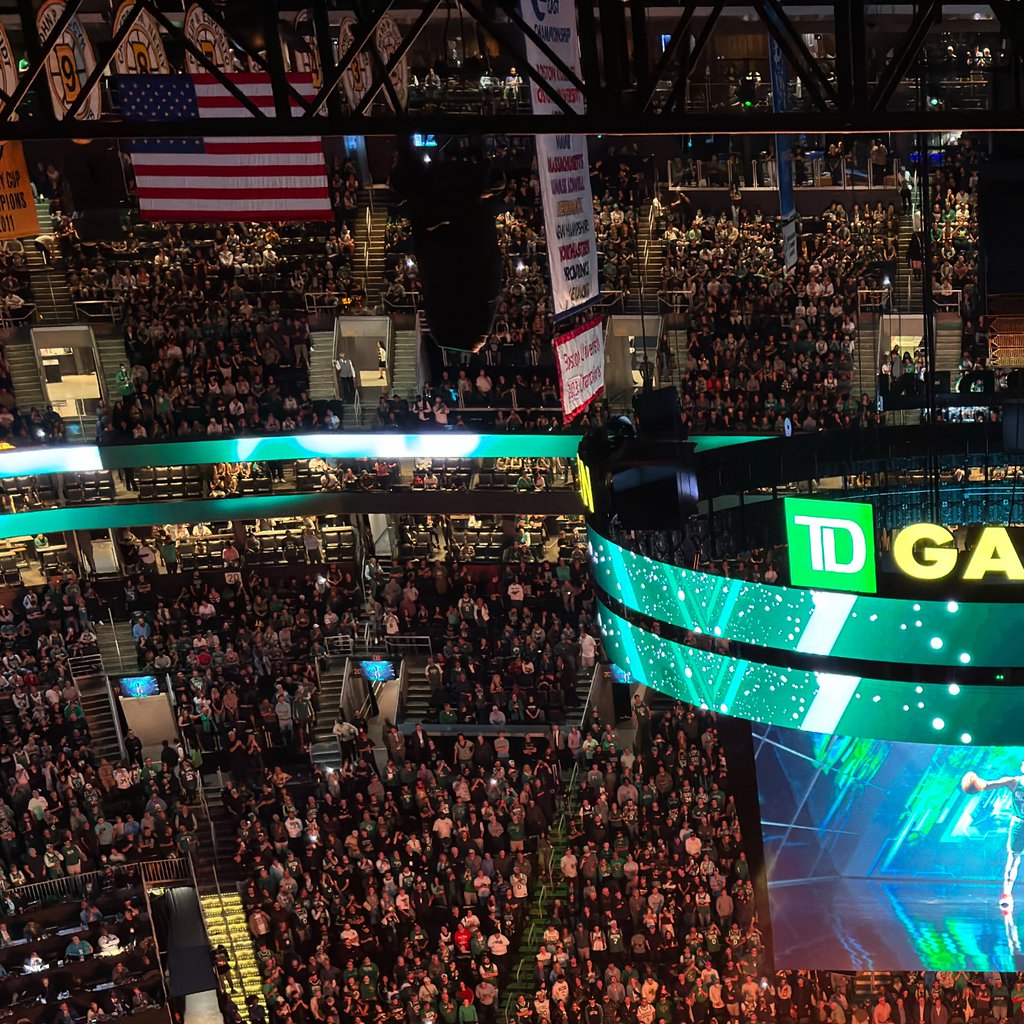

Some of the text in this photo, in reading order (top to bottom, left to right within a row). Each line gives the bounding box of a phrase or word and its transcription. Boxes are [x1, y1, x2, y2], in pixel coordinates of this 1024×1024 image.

[61, 55, 75, 92] 9
[0, 192, 27, 211] PIONS
[795, 515, 867, 574] TD
